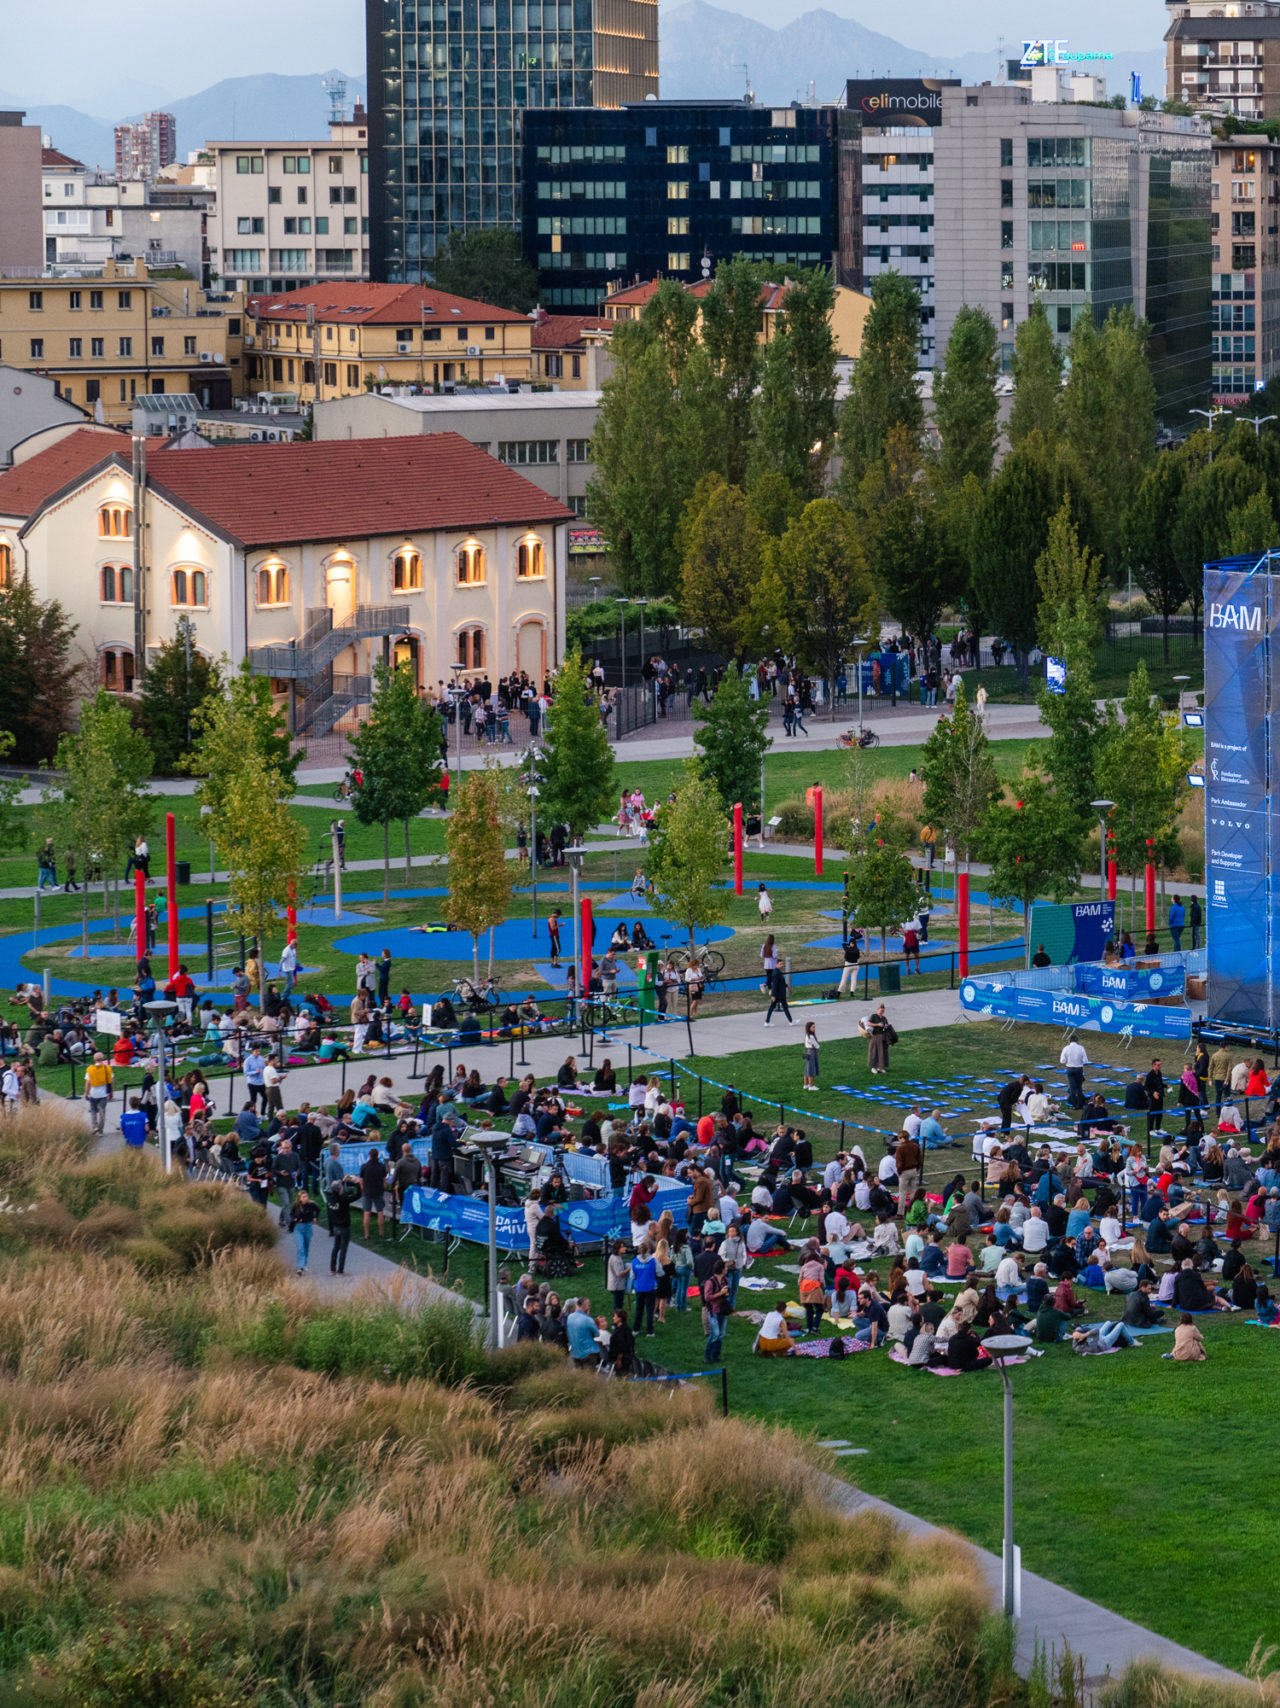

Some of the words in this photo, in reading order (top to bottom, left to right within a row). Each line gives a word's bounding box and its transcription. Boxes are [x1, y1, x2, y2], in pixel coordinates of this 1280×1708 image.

[1020, 40, 1068, 65] ZTE
[1047, 49, 1114, 62] Goupama
[1209, 603, 1262, 632] BAM
[1227, 744, 1241, 752] project
[1211, 796, 1220, 804] Park
[1221, 798, 1247, 808] Ambassador
[1211, 818, 1250, 830] VOLVO
[1211, 849, 1221, 857] Park
[1221, 850, 1243, 860] Developer
[1220, 859, 1242, 868] Supporter
[1076, 904, 1101, 917] BAM
[1102, 975, 1126, 990] BAM
[1053, 1000, 1080, 1016] BAM
